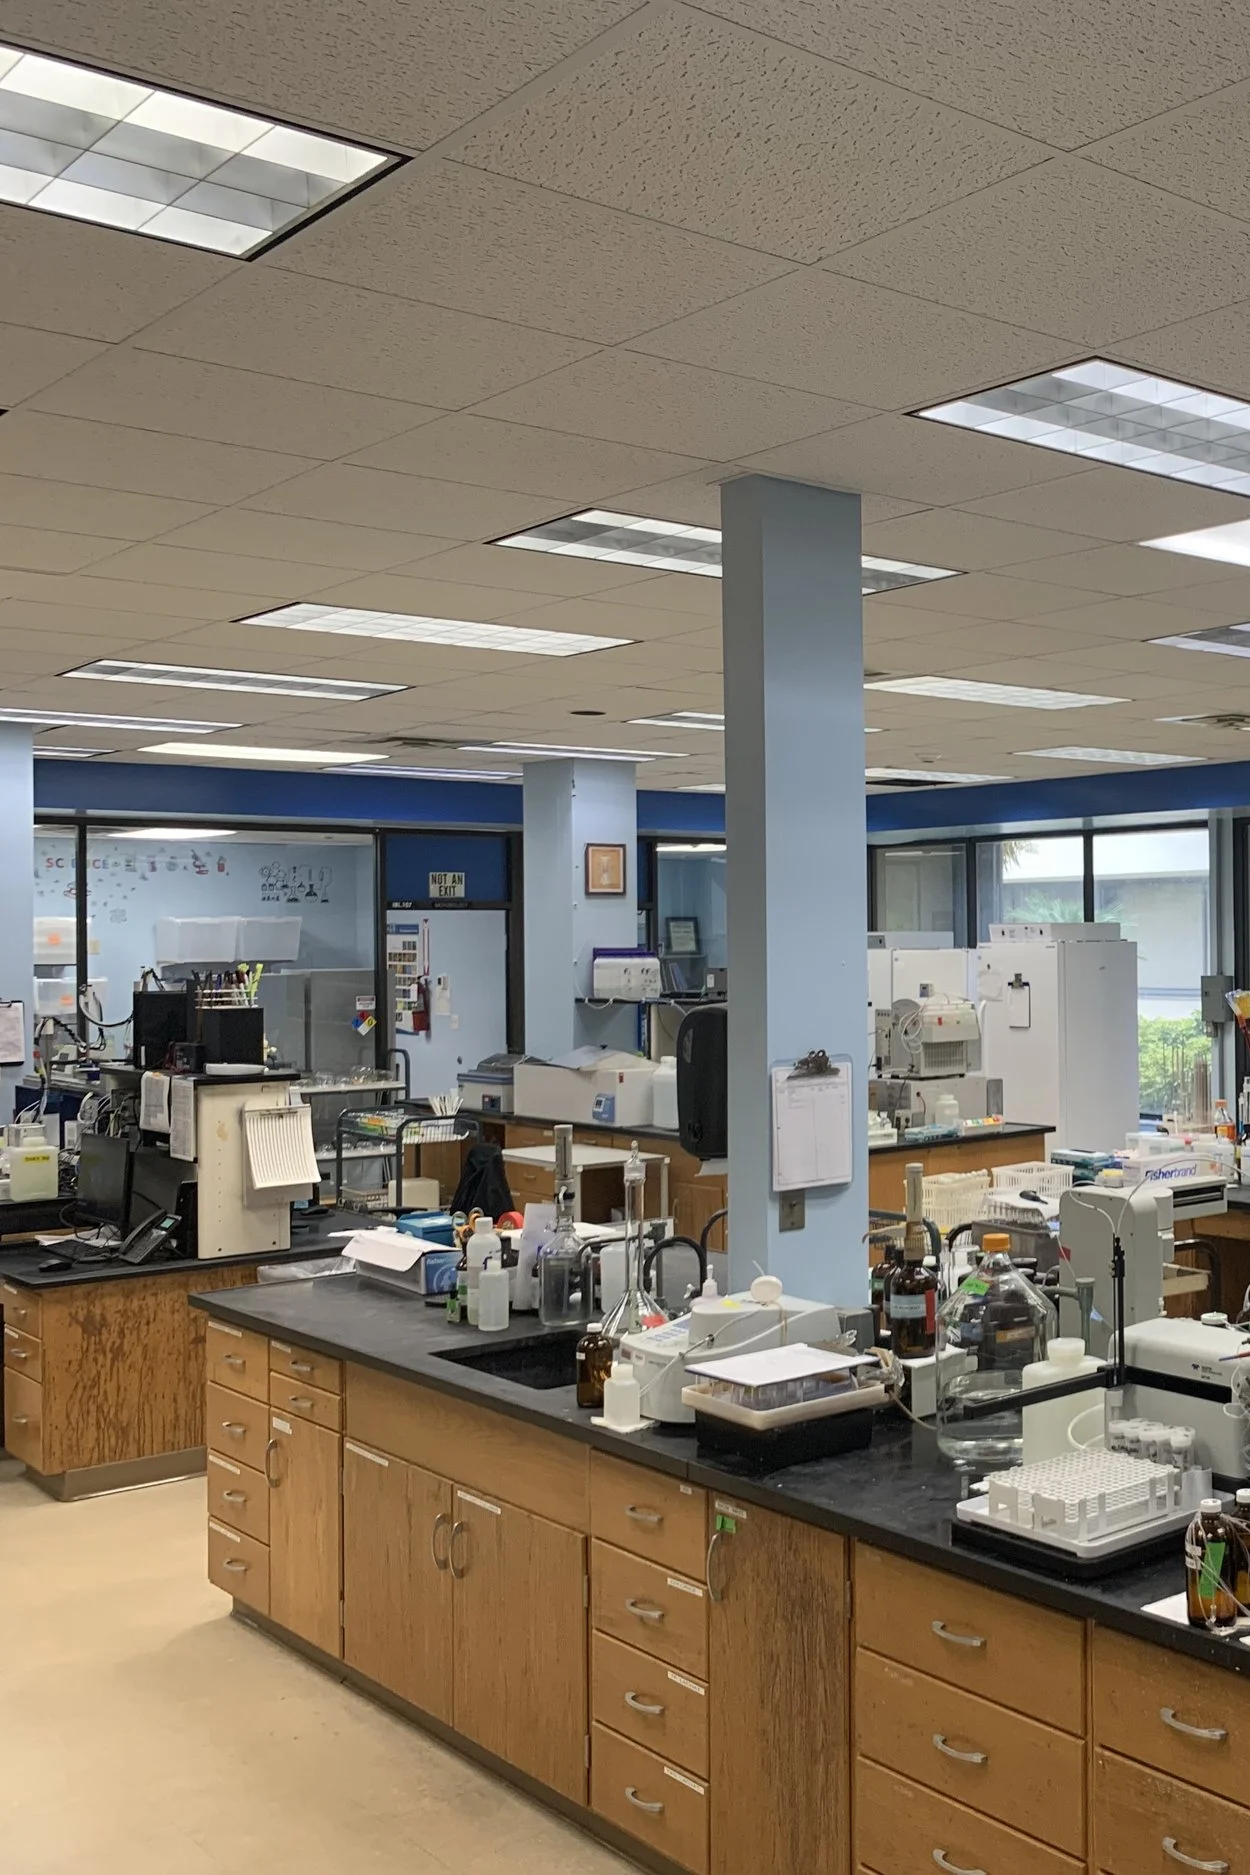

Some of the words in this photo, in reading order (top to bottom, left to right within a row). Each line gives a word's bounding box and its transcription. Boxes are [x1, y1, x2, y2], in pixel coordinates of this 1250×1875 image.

[431, 873, 447, 885] NOT
[451, 873, 463, 885] AN
[439, 885, 456, 897] EXIT
